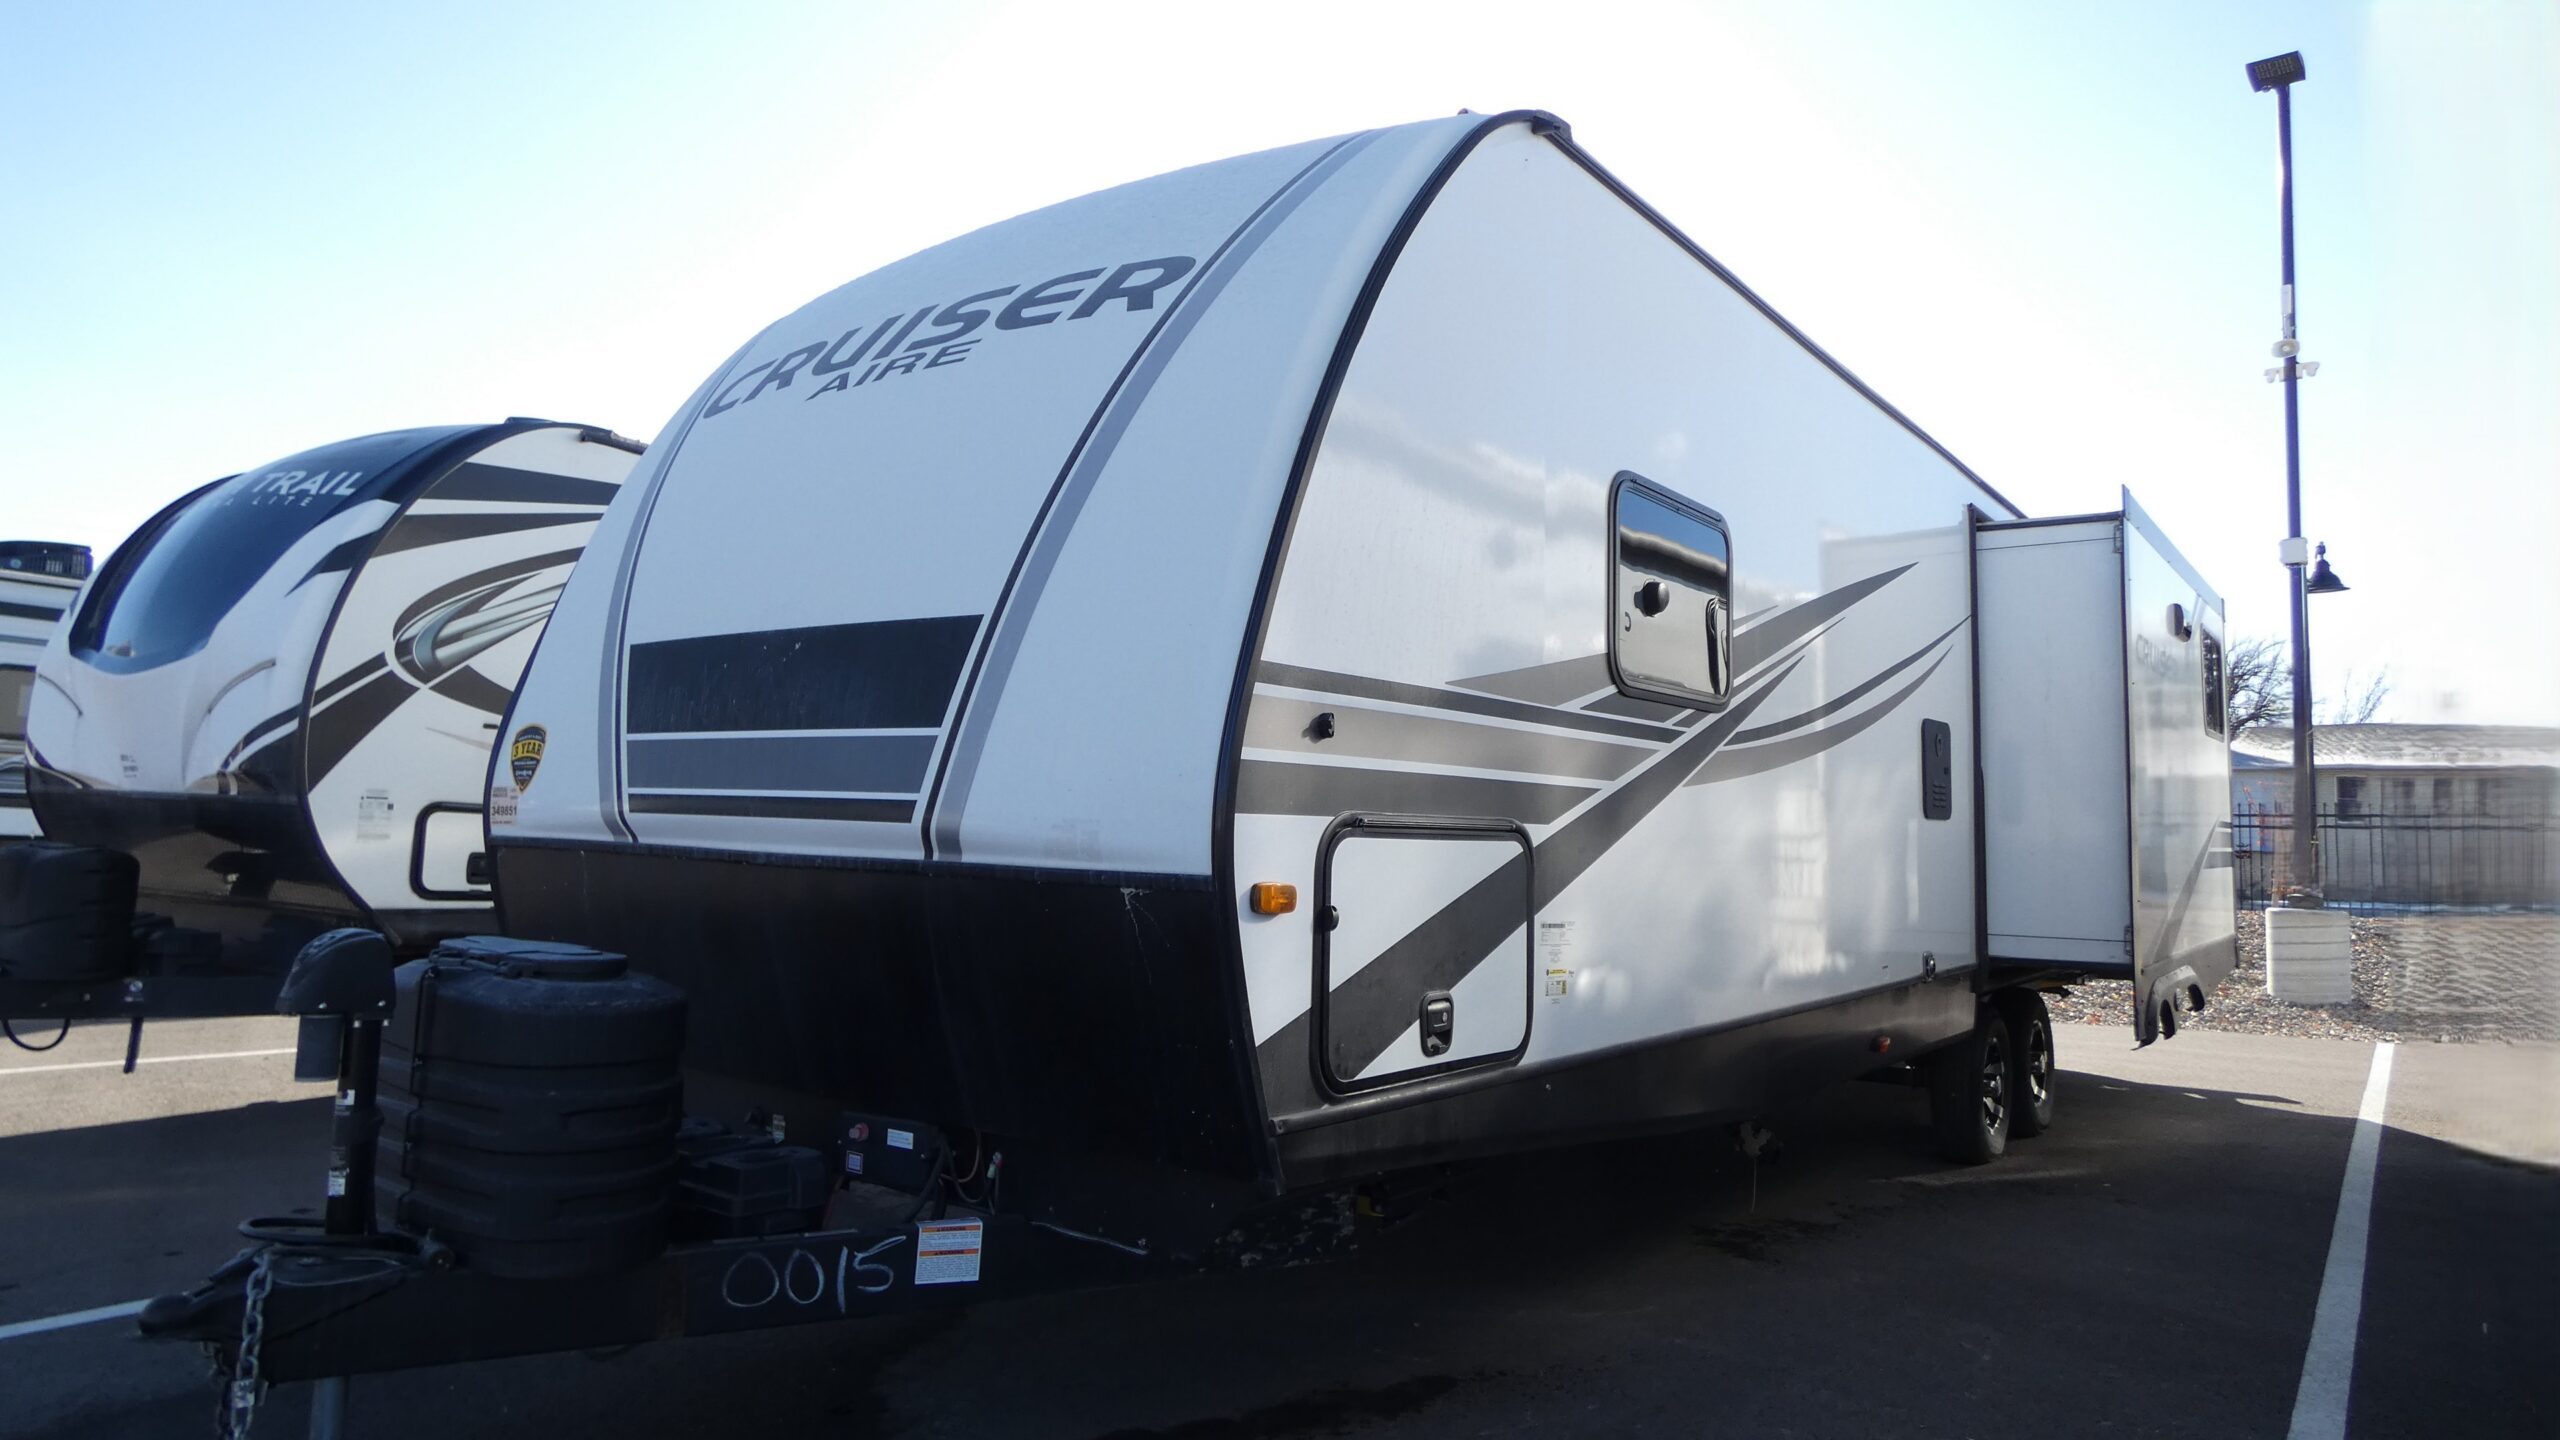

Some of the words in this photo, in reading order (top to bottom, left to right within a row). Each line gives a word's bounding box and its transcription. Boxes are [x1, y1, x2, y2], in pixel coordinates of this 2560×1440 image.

[703, 255, 1197, 420] CRUISER
[805, 338, 983, 402] AIRE
[251, 496, 313, 507] LITE
[252, 470, 363, 496] TRAIL
[521, 741, 542, 756] YEAR
[723, 1236, 907, 1314] 0015
